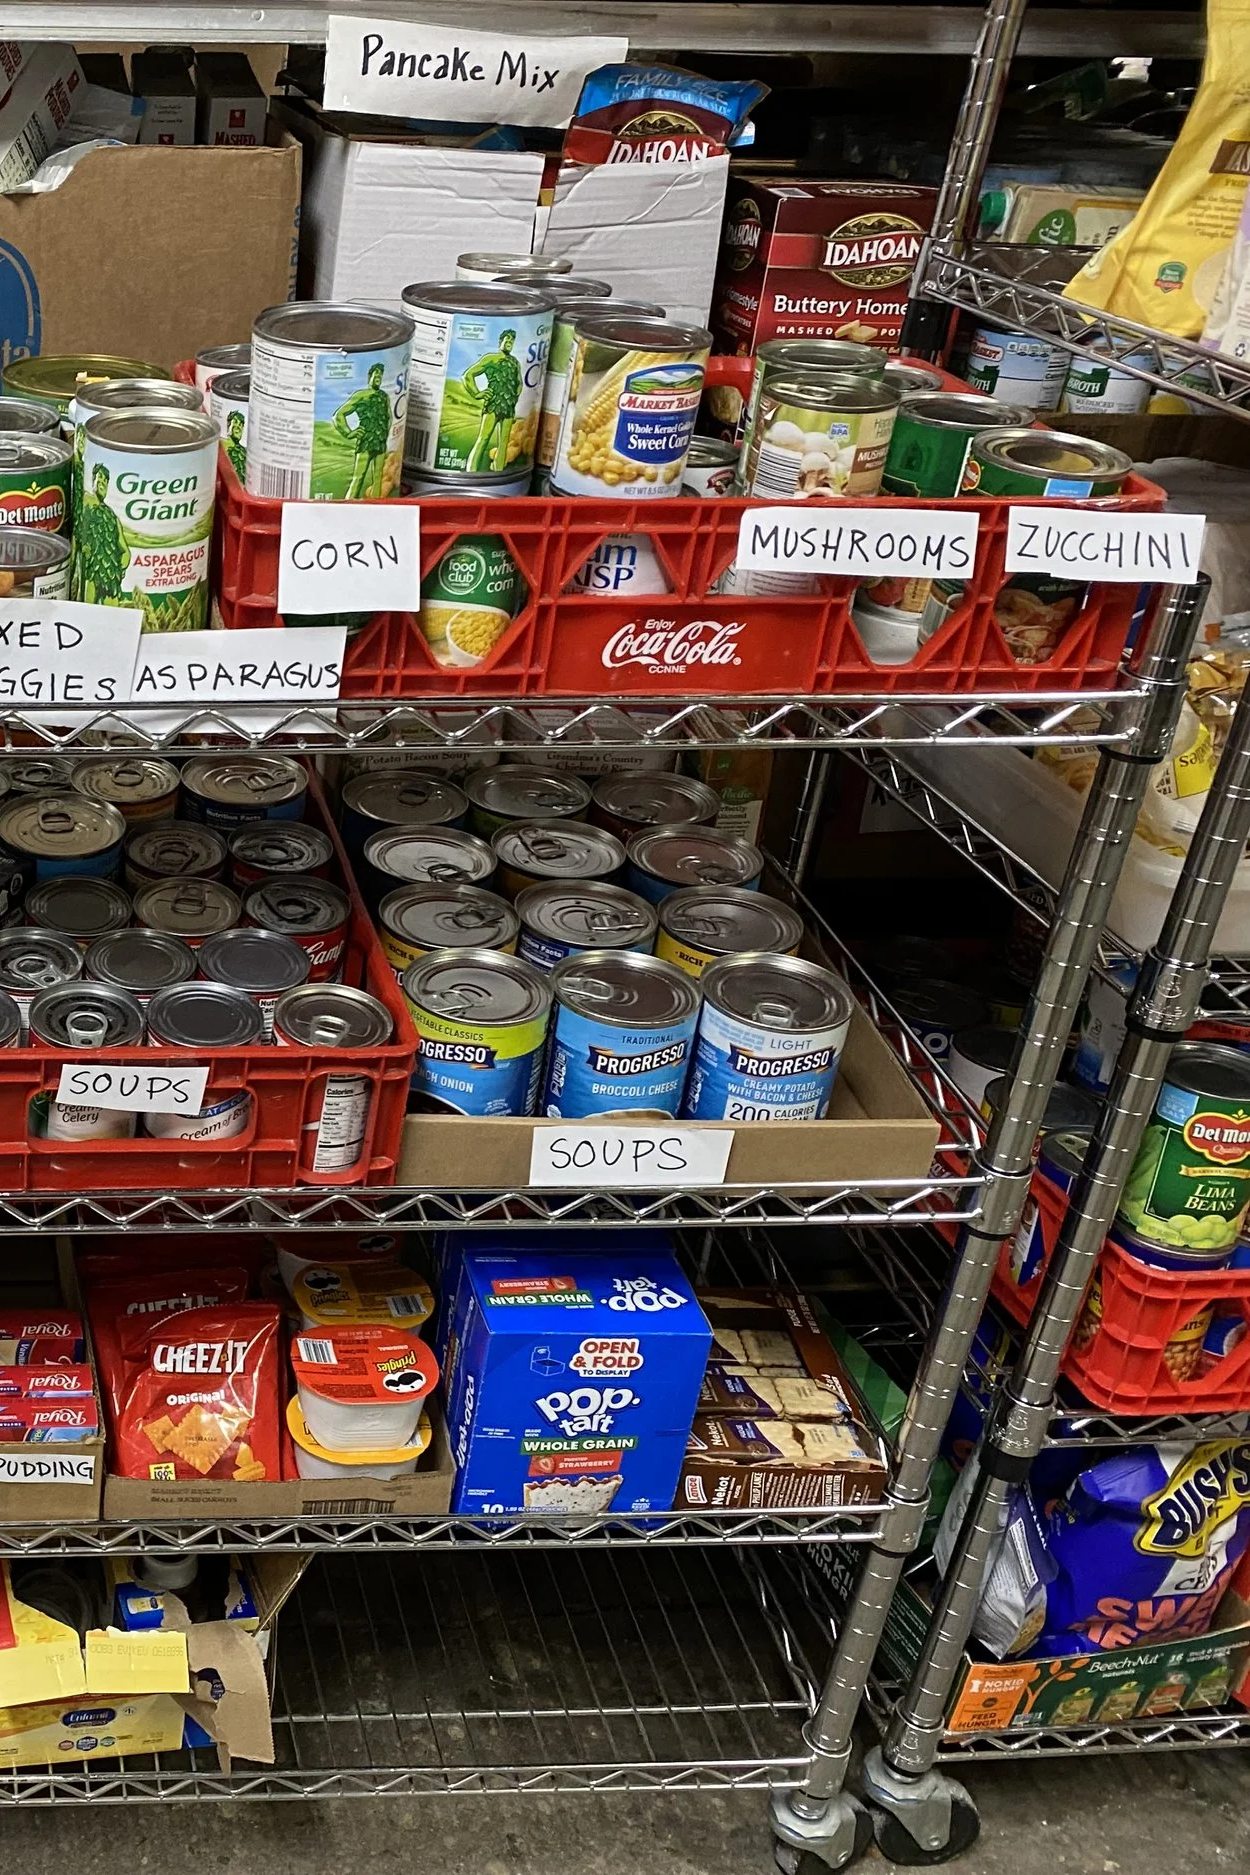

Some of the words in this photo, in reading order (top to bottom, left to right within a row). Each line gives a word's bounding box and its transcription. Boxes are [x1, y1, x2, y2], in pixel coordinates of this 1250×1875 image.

[361, 34, 486, 83] Pancake
[495, 50, 561, 93] Mix
[615, 72, 687, 90] FAMILY
[606, 139, 710, 164] IDAHOAN
[823, 236, 920, 267] IDAHOAN
[774, 295, 851, 317] Buttery
[777, 326, 833, 336] MASHED
[1066, 378, 1101, 393] BROTH
[621, 395, 674, 410] MARKET
[627, 423, 653, 434] Whole
[628, 434, 667, 450] Sweet
[116, 472, 198, 496] Green
[24, 504, 63, 522] Monte
[125, 498, 198, 521] Giant
[291, 535, 398, 571] CORN
[751, 524, 970, 571] MUSHROOMS
[1017, 523, 1189, 569] ZUCCHINI
[134, 545, 205, 567] ASPARAGUS
[153, 563, 193, 577] SPEARS
[448, 559, 477, 573] food
[146, 576, 173, 588] EXTRA
[174, 572, 197, 584] LONG
[448, 570, 474, 584] club
[645, 619, 675, 631] Enjoy
[602, 620, 747, 668] Coca-Cola
[136, 661, 341, 693] ASPARAGUS
[648, 665, 686, 674] CCNNE
[366, 753, 399, 764] Potato
[401, 753, 436, 764] Bacon
[440, 751, 471, 764] Soup
[547, 753, 599, 765] Grandma's
[602, 754, 644, 768] Country
[444, 1027, 484, 1042] CLASSICS
[622, 1034, 674, 1045] TRADITIONAL
[419, 1039, 486, 1063] OGRESSO
[770, 1039, 813, 1050] LIGHT
[597, 1044, 686, 1075] PROGRESSO
[736, 1050, 830, 1077] PROGRESSO
[69, 1071, 190, 1103] SOUPS
[441, 1076, 474, 1093] ONION
[592, 1082, 646, 1096] BROCCOLI
[649, 1080, 679, 1094] CHEESE
[727, 1082, 752, 1097] WITH
[755, 1089, 787, 1102] BACON
[796, 1087, 824, 1101] CHEESE
[743, 1078, 783, 1092] CREAMY
[784, 1081, 816, 1093] POTATO
[62, 1111, 99, 1124] Celery
[731, 1103, 770, 1120] 200
[774, 1105, 815, 1118] CALORIES
[222, 1116, 232, 1127] of
[1193, 1125, 1220, 1141] Del
[550, 1138, 687, 1172] SOUPS
[1194, 1183, 1235, 1198] LIMA
[1184, 1196, 1236, 1211] BEANS
[490, 1295, 537, 1305] GRAIN
[540, 1293, 593, 1303] WHOLE
[22, 1322, 71, 1338] Royal
[584, 1341, 636, 1354] OPEN
[377, 1350, 417, 1374] Pringles
[573, 1357, 586, 1368] &
[593, 1357, 640, 1369] FOLD
[30, 1374, 81, 1391] Royal
[34, 1408, 86, 1426] Royal
[559, 1414, 614, 1437] tart
[524, 1440, 579, 1451] WHOLE
[582, 1438, 634, 1450] GRAIN
[559, 1459, 614, 1469] STRAWBERRY
[687, 1476, 699, 1503] Lance
[711, 1475, 732, 1506] Nekot
